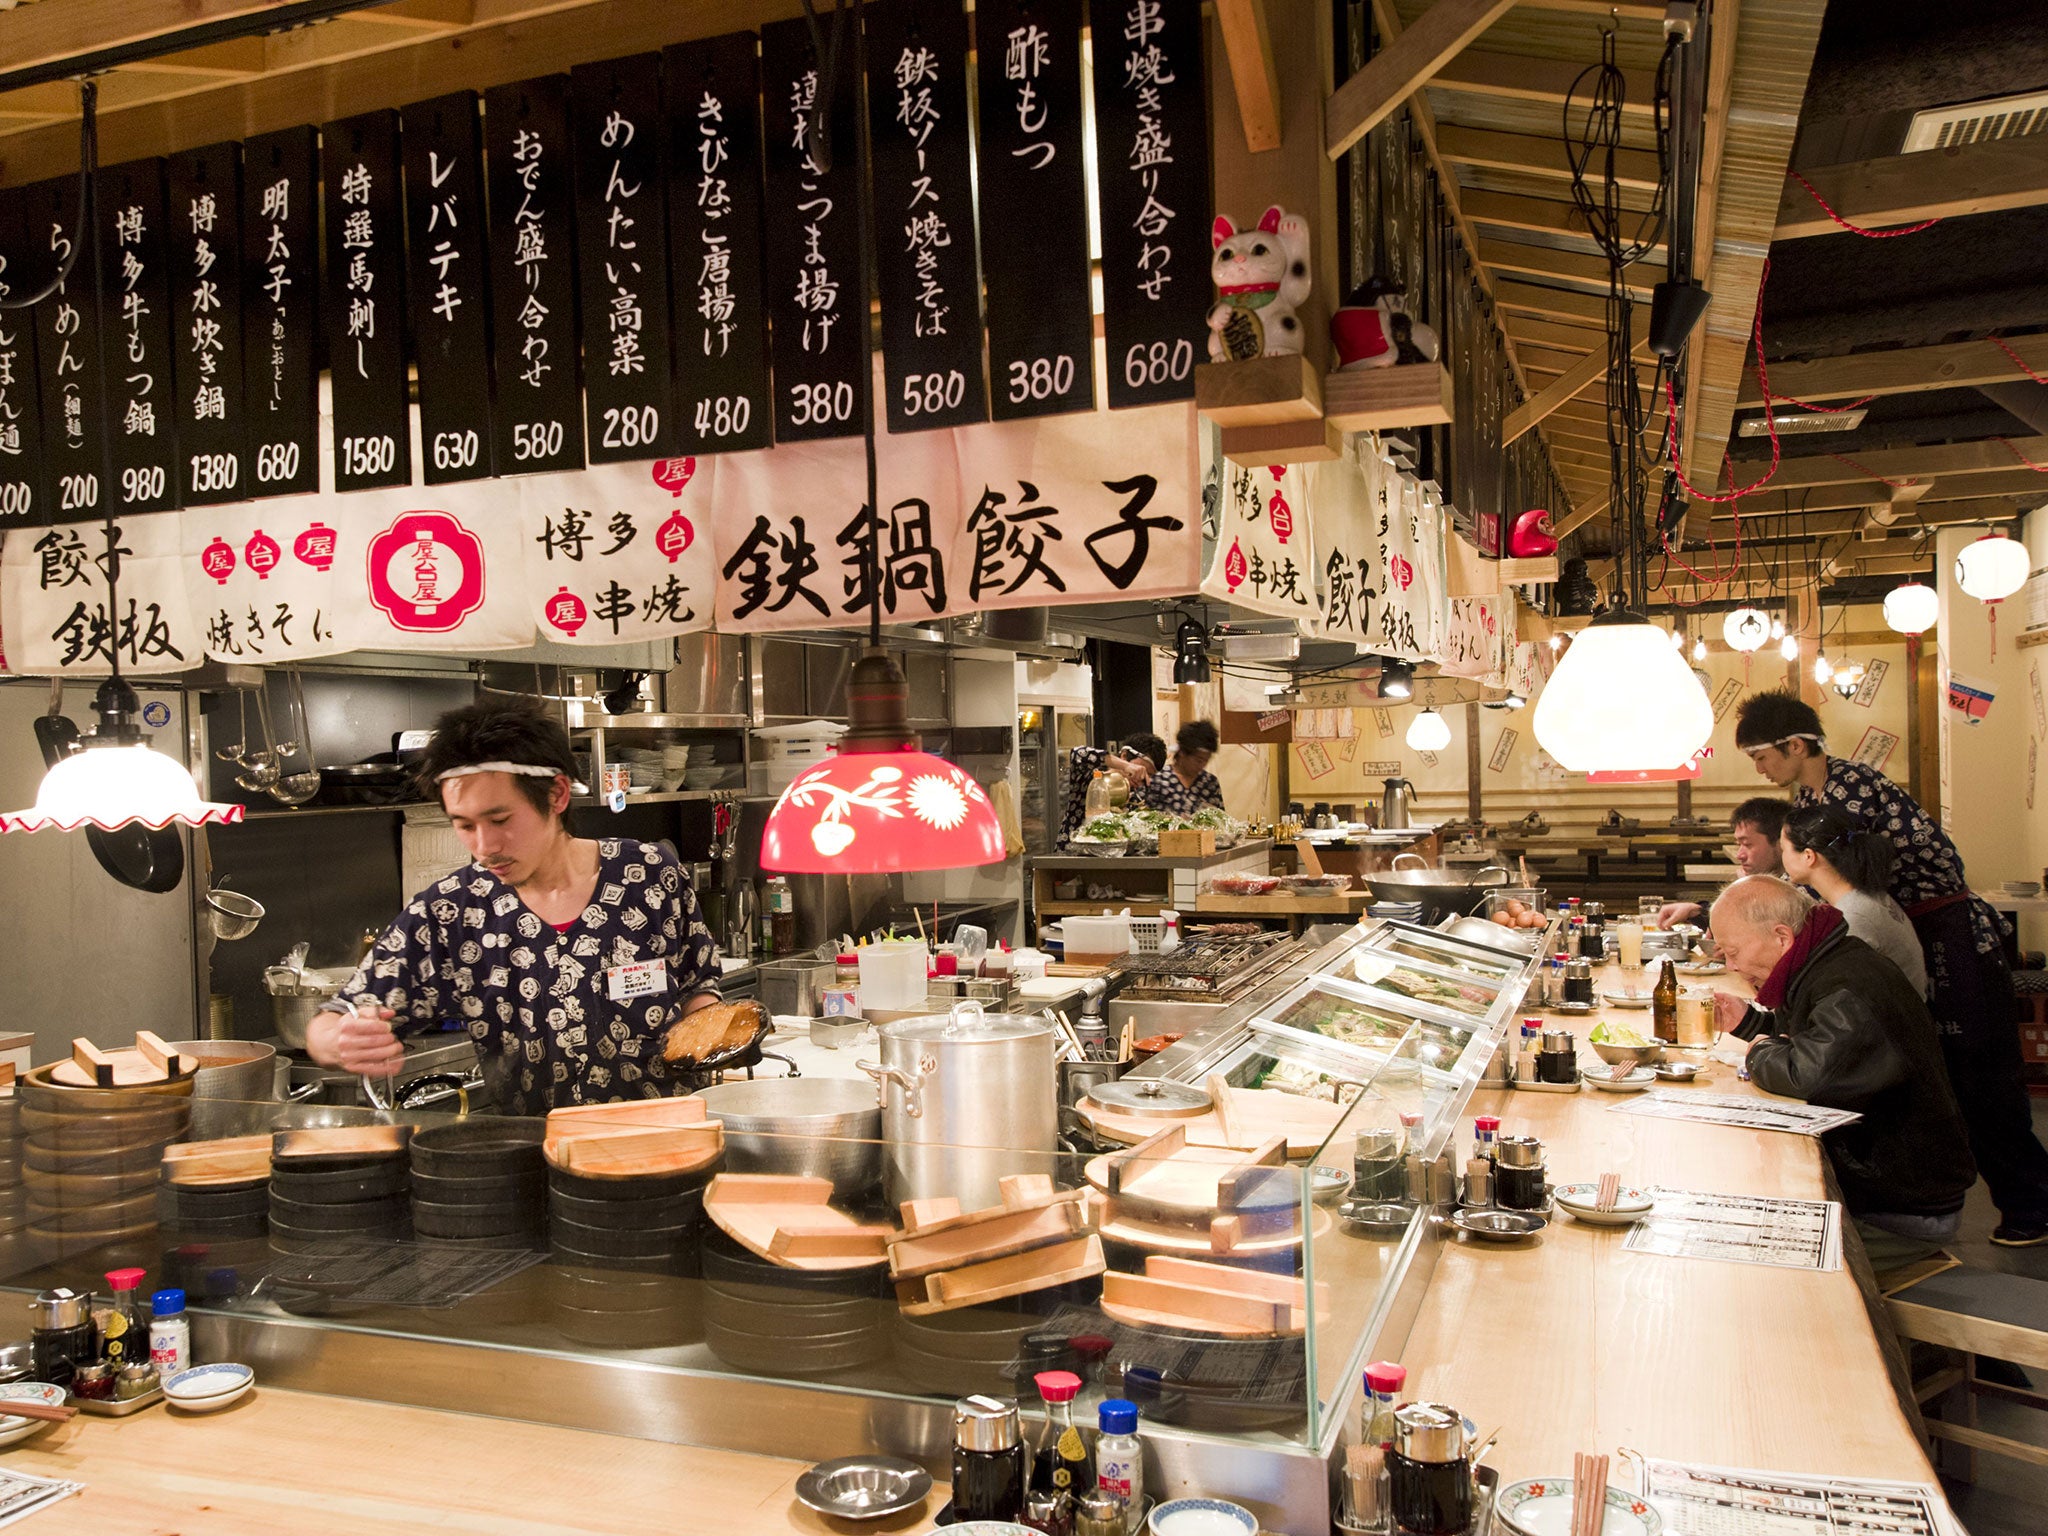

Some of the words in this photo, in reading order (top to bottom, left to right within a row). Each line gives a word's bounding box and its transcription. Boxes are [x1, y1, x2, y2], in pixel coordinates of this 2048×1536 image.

[1006, 26, 1054, 168] 酢もつ
[1125, 1, 1175, 299] 串焼き盛り合わせ
[895, 48, 950, 337] 鉄板ソース焼きそば
[429, 152, 461, 321] レバテキ
[602, 112, 645, 375] めんたい高菜
[698, 92, 737, 355] きびなご唐揚げ
[342, 164, 374, 378] 特選馬刺し
[514, 131, 550, 387] おでん盛り合わせ
[116, 207, 155, 435] 博多牛もつ鍋
[190, 193, 225, 419] 博多水炊き鍋
[904, 370, 964, 415] 580
[1009, 356, 1073, 402] 380
[1126, 340, 1192, 387] 680
[603, 406, 658, 447] 280
[695, 396, 749, 438] 480
[791, 382, 852, 424] 380
[258, 442, 299, 481] 680
[343, 436, 394, 475] 1580
[434, 430, 478, 469] 630
[515, 421, 563, 460] 580
[0, 482, 31, 515] 00
[60, 474, 98, 509] 200
[123, 466, 164, 502] 980
[191, 453, 237, 491] 1380
[33, 525, 133, 590] 餃子
[536, 508, 637, 561] 博多
[722, 474, 1184, 620] 鉄鍋餃子
[410, 539, 442, 602] 屋台屋
[1250, 546, 1308, 606] 串焼
[1326, 546, 1377, 636] 餃子
[52, 598, 184, 667] 鉄板
[592, 573, 695, 635] 串焼
